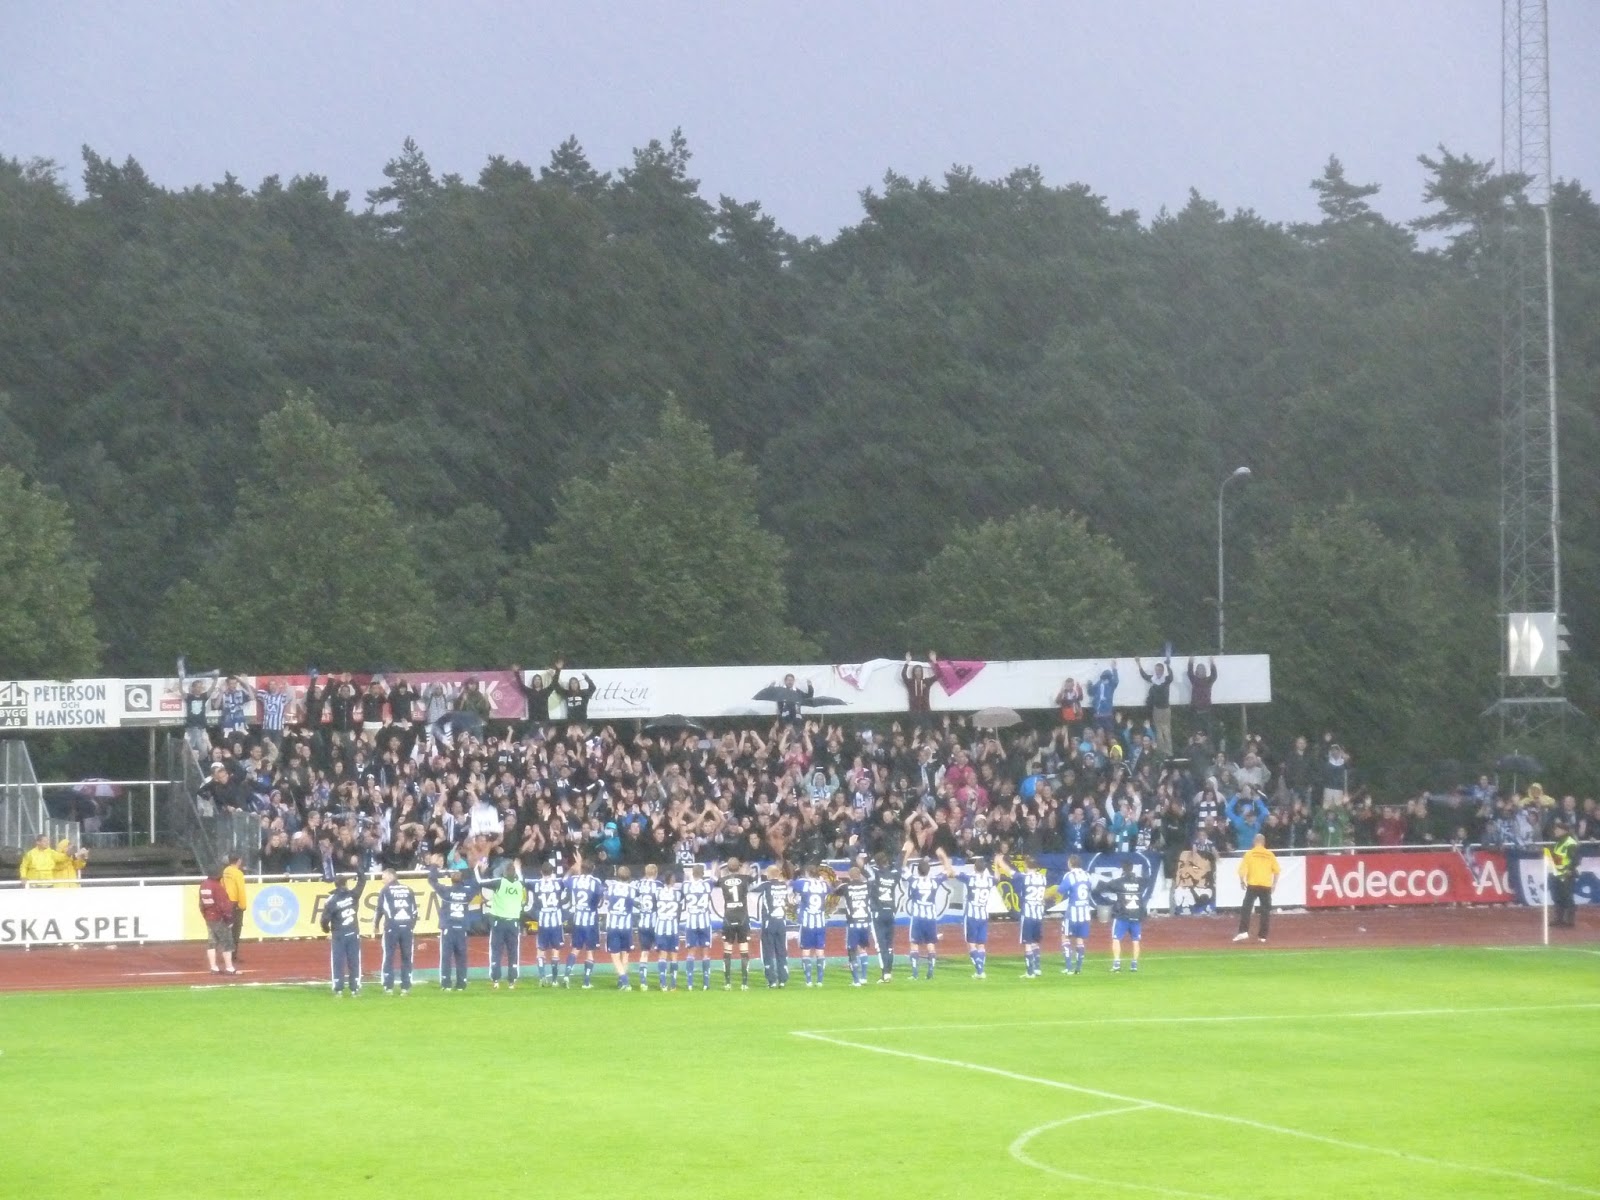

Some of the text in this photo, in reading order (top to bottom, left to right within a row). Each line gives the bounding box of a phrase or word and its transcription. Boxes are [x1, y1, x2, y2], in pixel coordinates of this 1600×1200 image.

[34, 685, 105, 701] PETERSON
[128, 688, 150, 708] Q
[0, 709, 27, 718] BYGG
[35, 709, 105, 726] HANSSON
[5, 718, 21, 726] AB
[1312, 861, 1449, 899] Adecco
[505, 887, 518, 895] ICA
[576, 891, 589, 907] 2
[729, 886, 739, 902] 1
[919, 889, 932, 902] 7
[972, 888, 989, 903] 19
[1077, 884, 1088, 900] 6
[538, 892, 559, 908] 14
[613, 898, 626, 912] 4
[657, 900, 679, 916] 22
[686, 894, 709, 910] 24
[809, 894, 822, 909] 9
[1, 916, 148, 942] SKA SPEL
